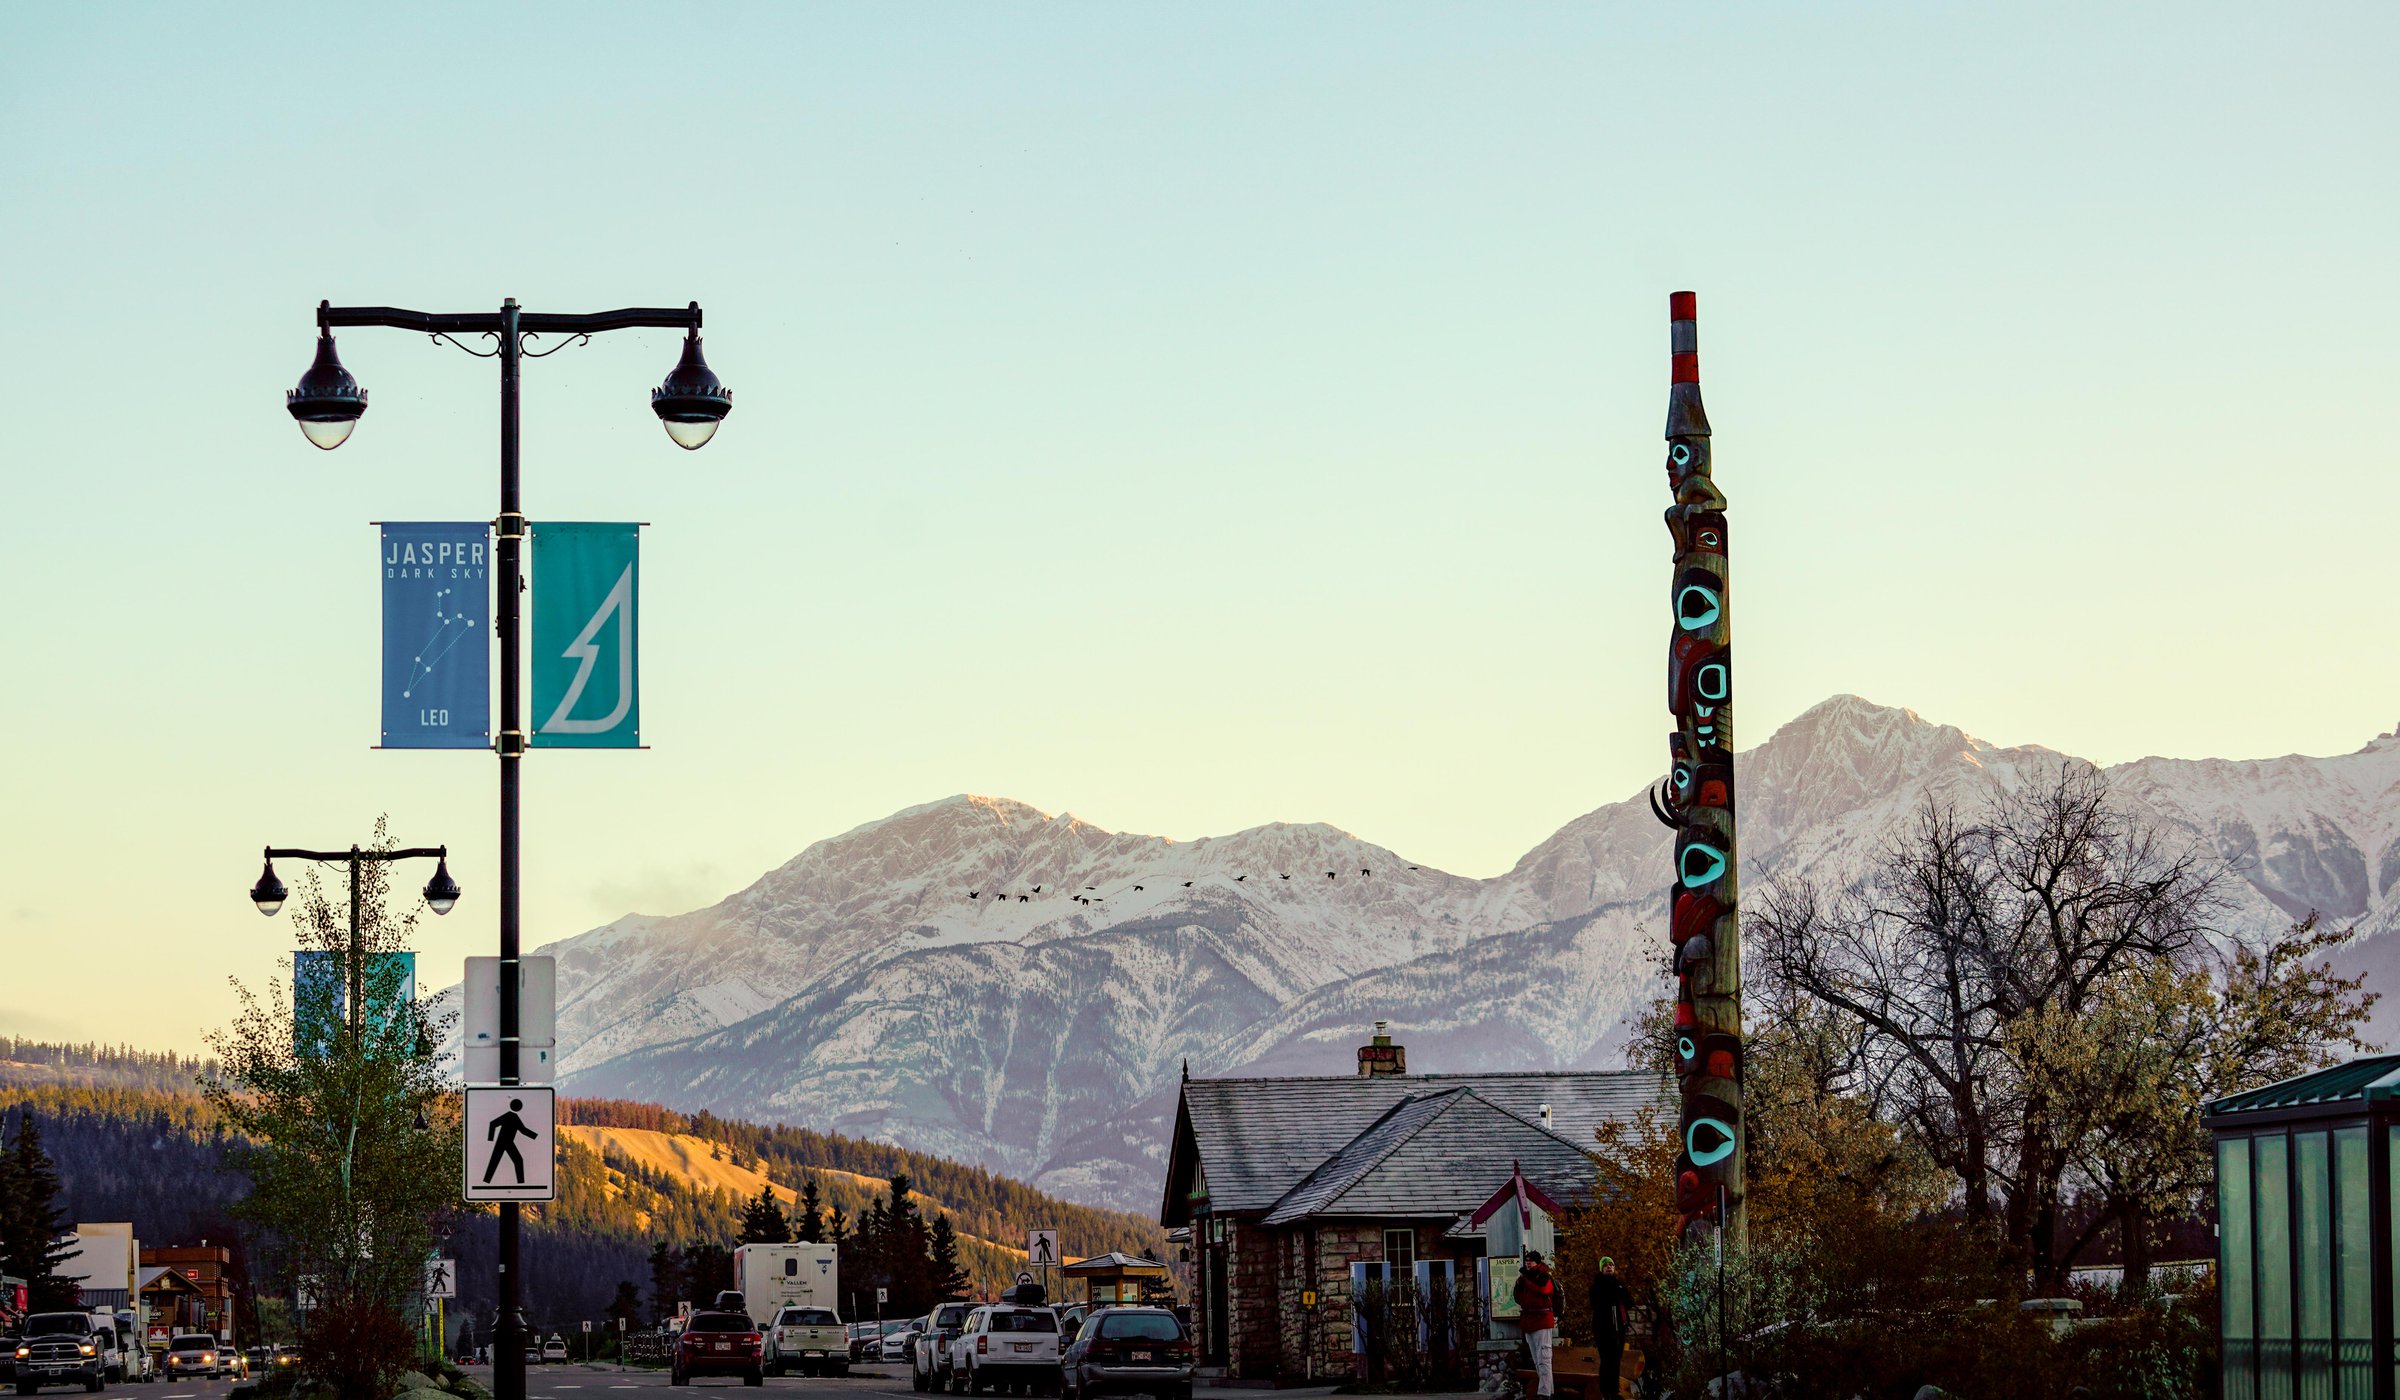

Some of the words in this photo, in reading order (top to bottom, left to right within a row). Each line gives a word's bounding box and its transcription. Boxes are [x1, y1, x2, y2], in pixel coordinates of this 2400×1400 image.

[386, 542, 484, 565] JASPER
[388, 568, 434, 578] DARK
[451, 568, 483, 579] SKY
[421, 709, 449, 726] LEO
